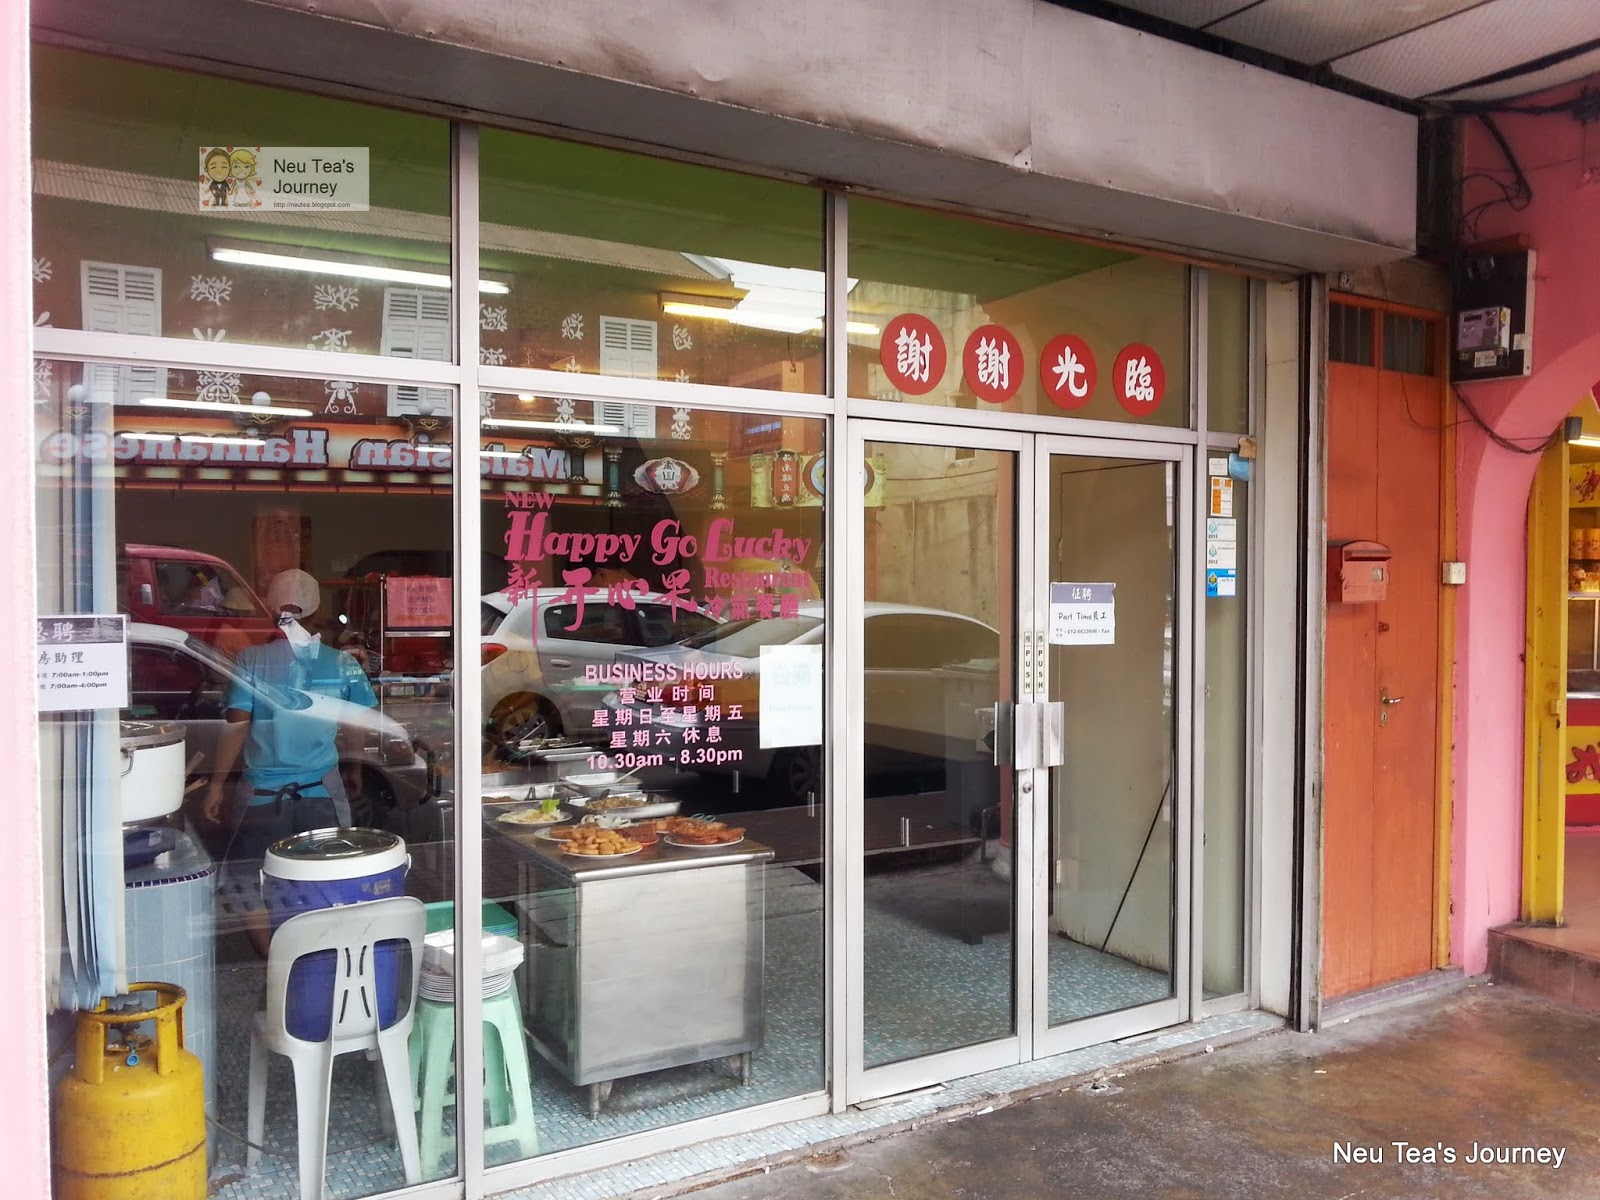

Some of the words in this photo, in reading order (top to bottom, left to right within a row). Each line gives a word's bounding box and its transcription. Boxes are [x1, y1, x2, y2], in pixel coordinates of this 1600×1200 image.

[895, 326, 1155, 402] 謝謝光臨
[504, 492, 555, 509] NEW
[504, 511, 642, 563] Happy
[651, 519, 697, 566] Go
[702, 518, 812, 564] Lucky
[704, 567, 810, 588] Restaurant
[1058, 612, 1073, 620] Part
[585, 662, 678, 683] BUSINESS
[683, 661, 744, 680] HOURS
[619, 684, 715, 705] 营业时间
[592, 704, 744, 727] 星期日至星期五
[586, 753, 663, 770] 10.30am
[680, 747, 743, 766] 8.30pm
